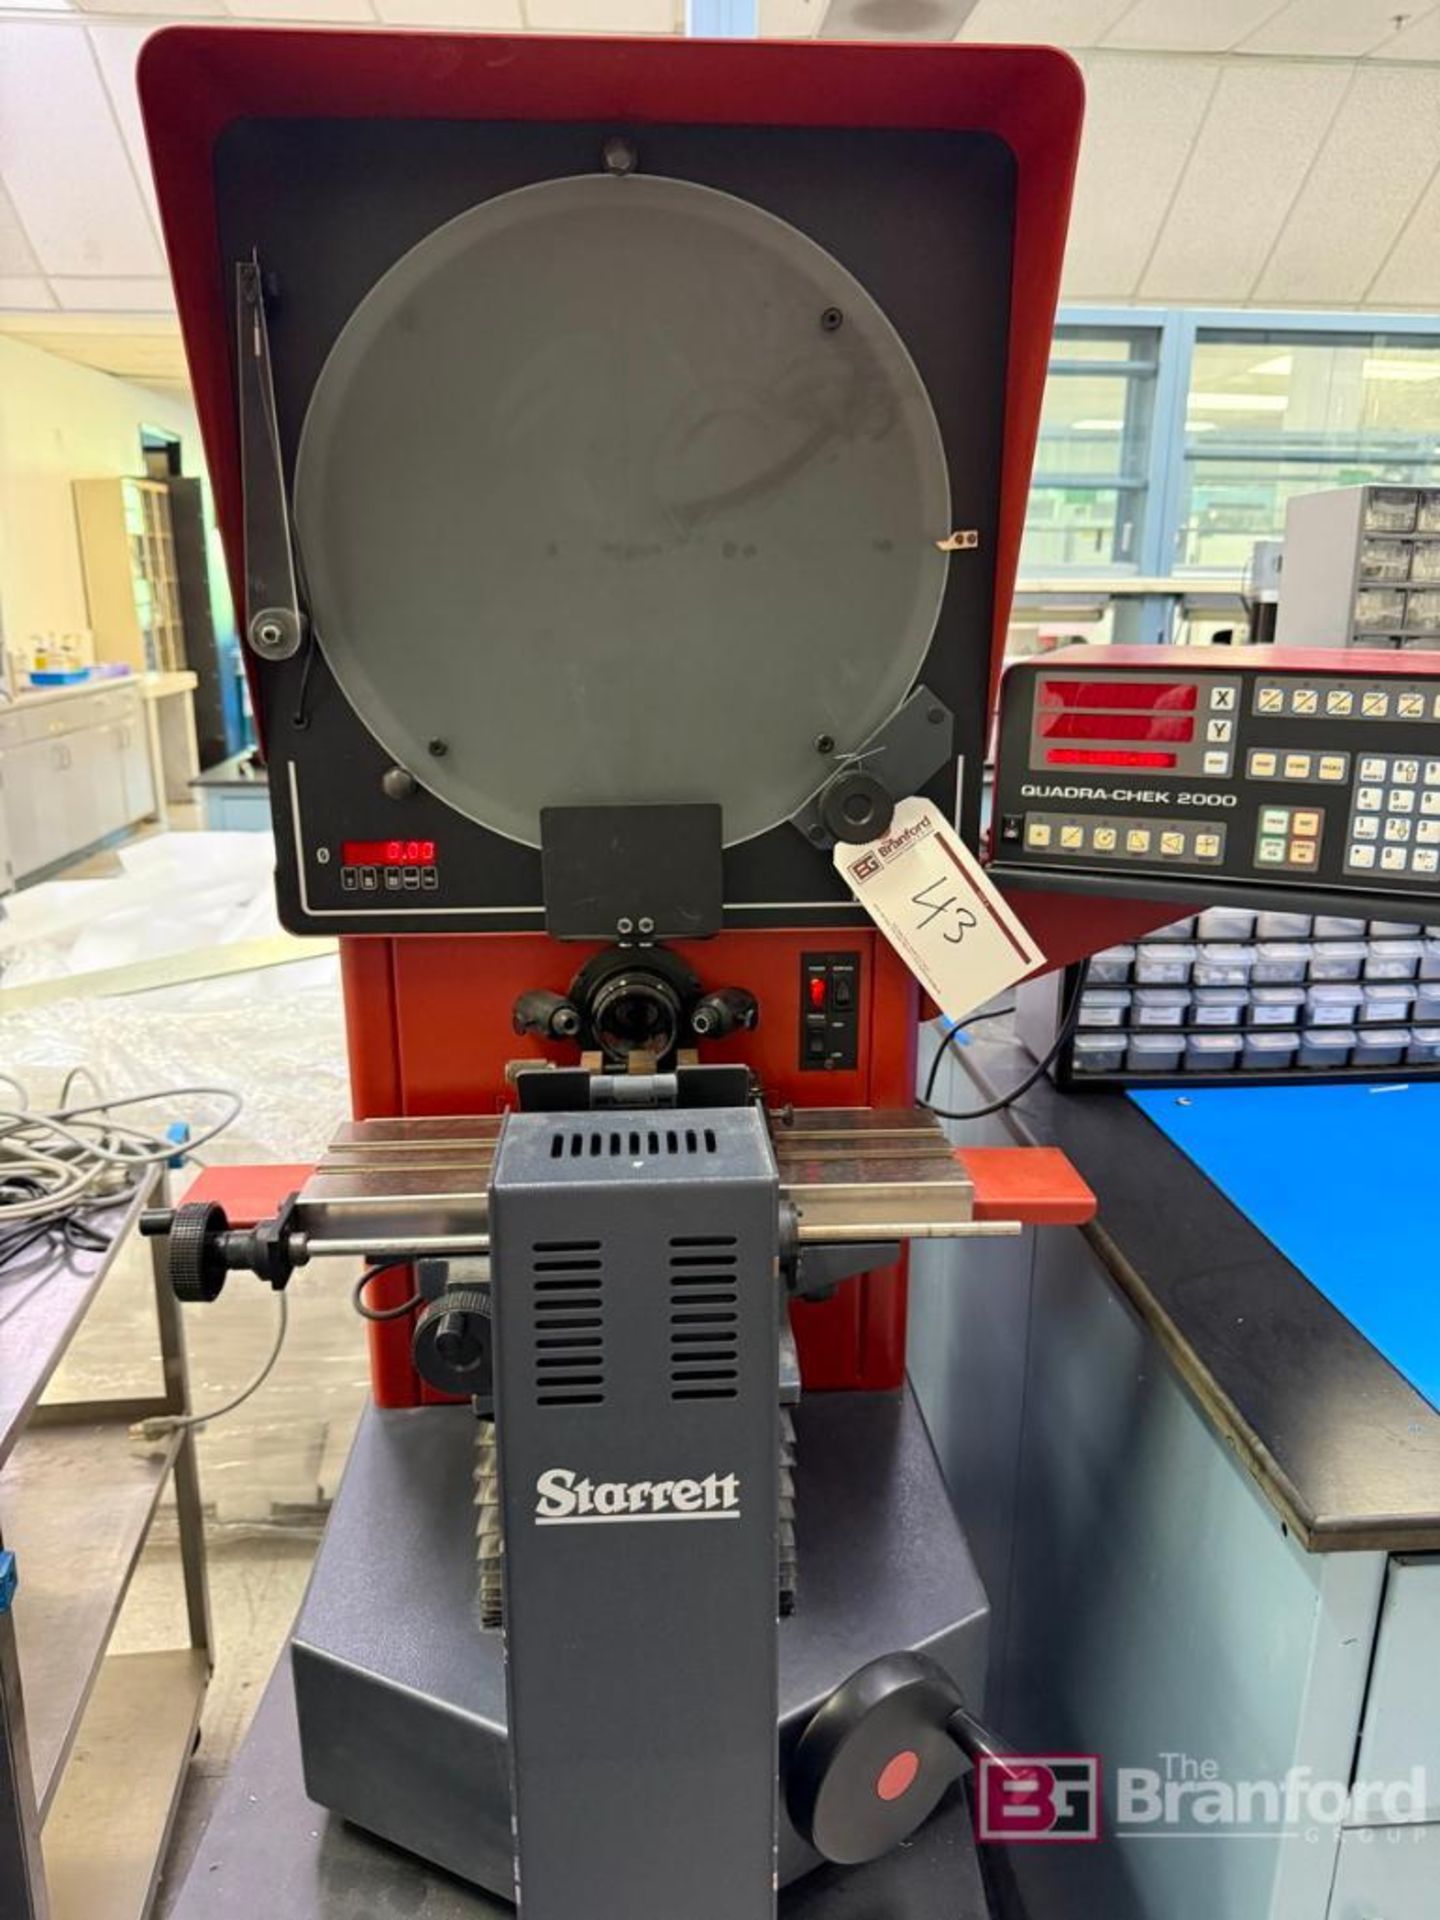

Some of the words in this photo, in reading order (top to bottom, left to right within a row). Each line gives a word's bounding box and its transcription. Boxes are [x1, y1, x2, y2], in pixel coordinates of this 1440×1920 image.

[1216, 691, 1230, 706] X
[1213, 722, 1227, 738] Y
[1020, 784, 1170, 804] QUADRA-CHEK
[1176, 794, 1238, 807] 2000
[877, 815, 932, 857] Branford
[911, 876, 977, 944] 43
[535, 1468, 740, 1517] Starrett
